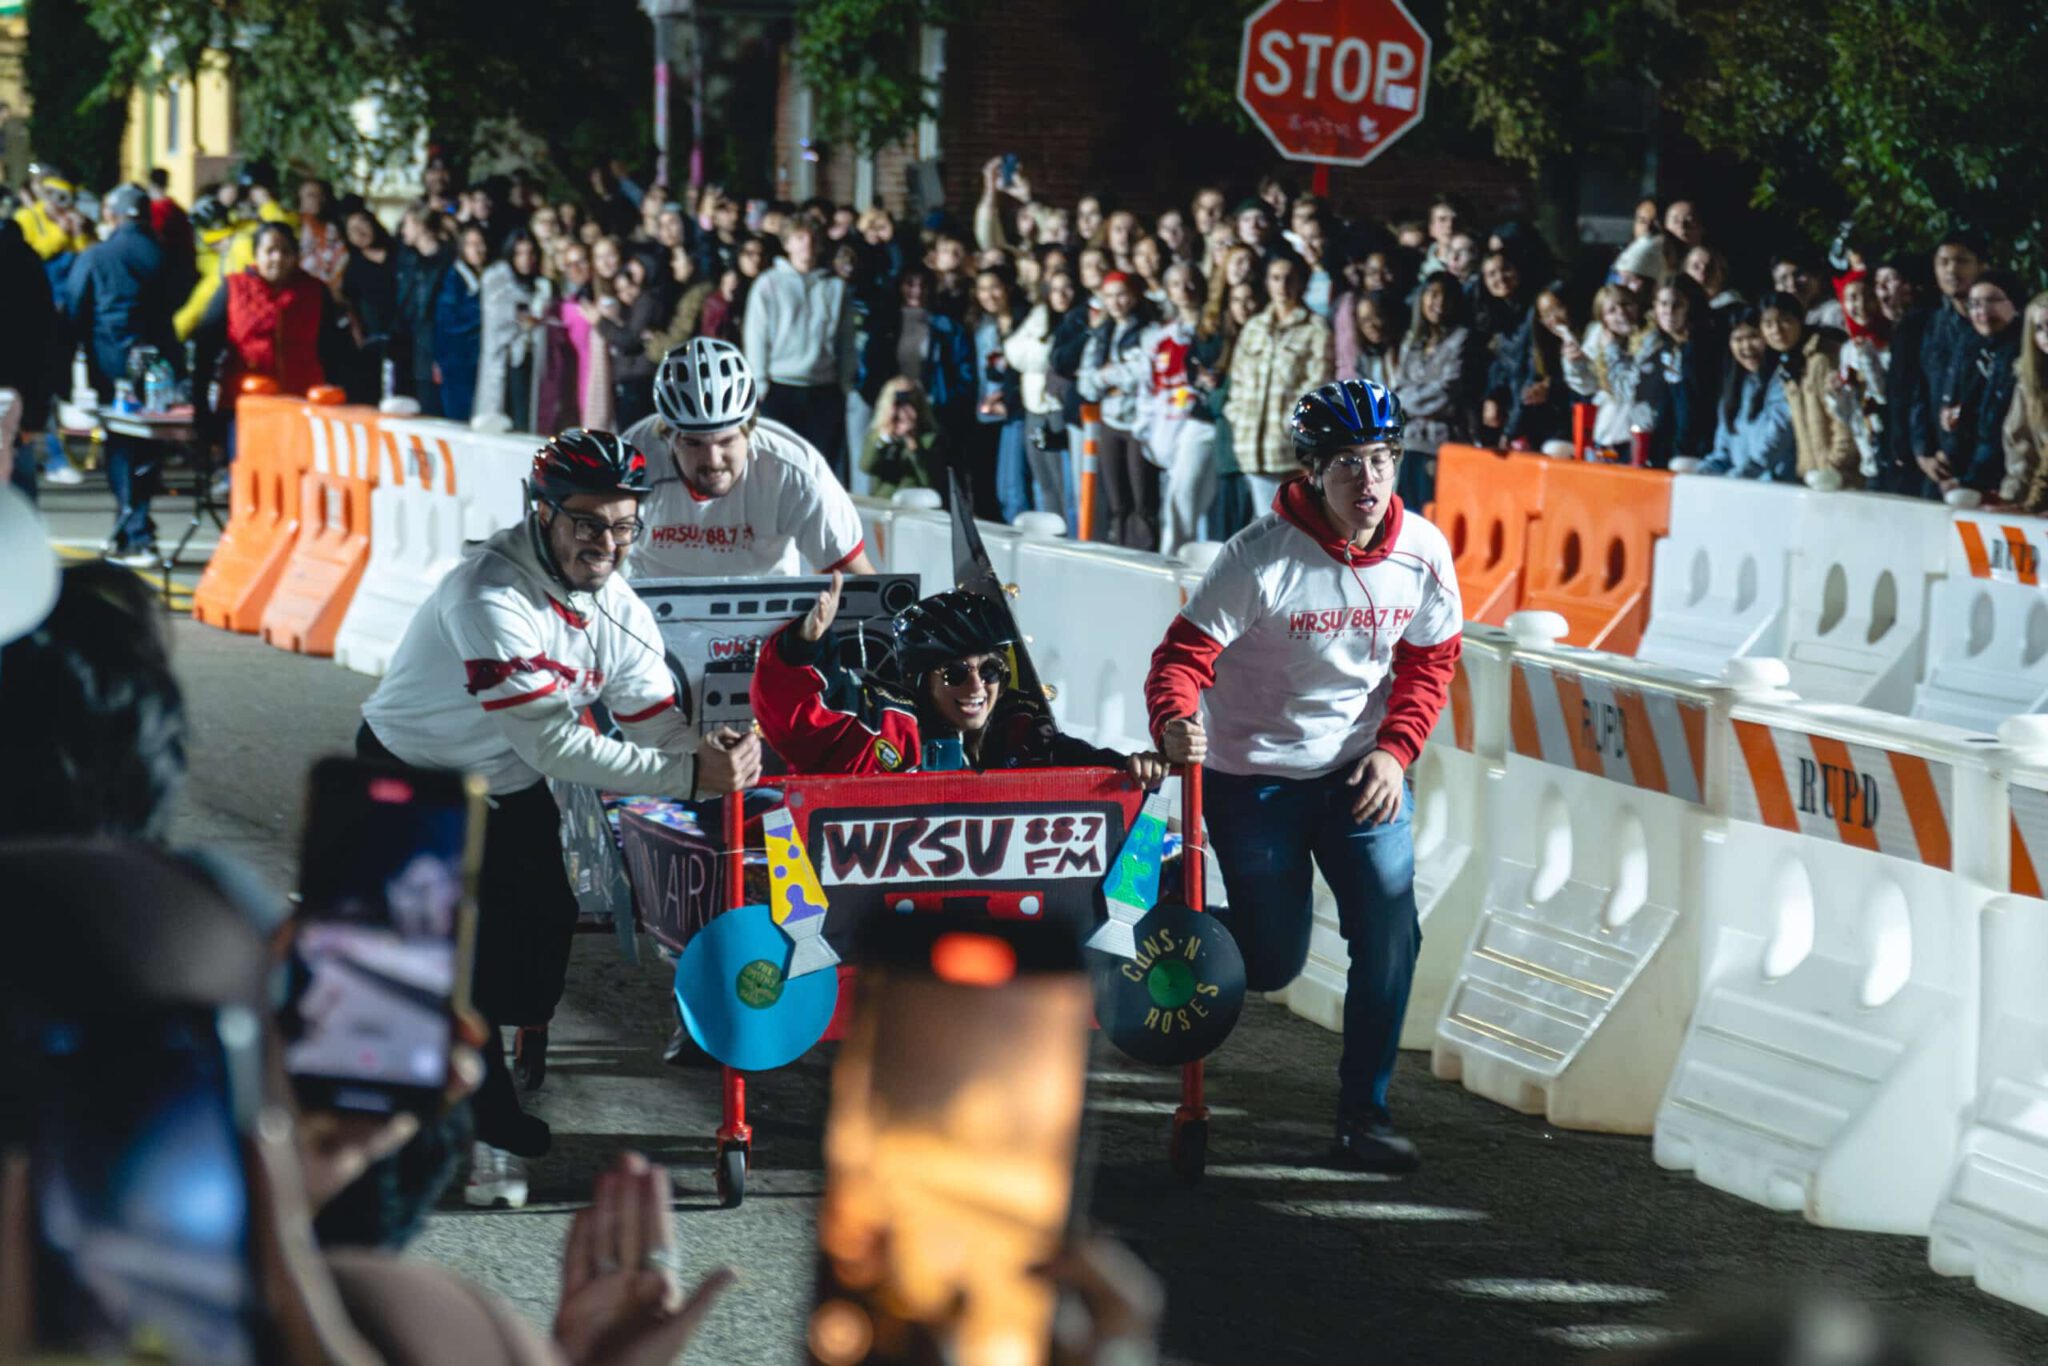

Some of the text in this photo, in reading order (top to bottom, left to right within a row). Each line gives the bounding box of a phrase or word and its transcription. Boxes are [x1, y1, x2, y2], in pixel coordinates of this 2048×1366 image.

[1254, 30, 1416, 106] STOP
[1392, 608, 1415, 627] FM
[1797, 756, 1880, 830] RUPD
[823, 816, 1105, 882] WRSU 88.7
[1025, 847, 1104, 876] FM
[663, 853, 706, 933] AIR
[1121, 928, 1175, 982] GUNS
[1143, 982, 1219, 1035] ROSES
